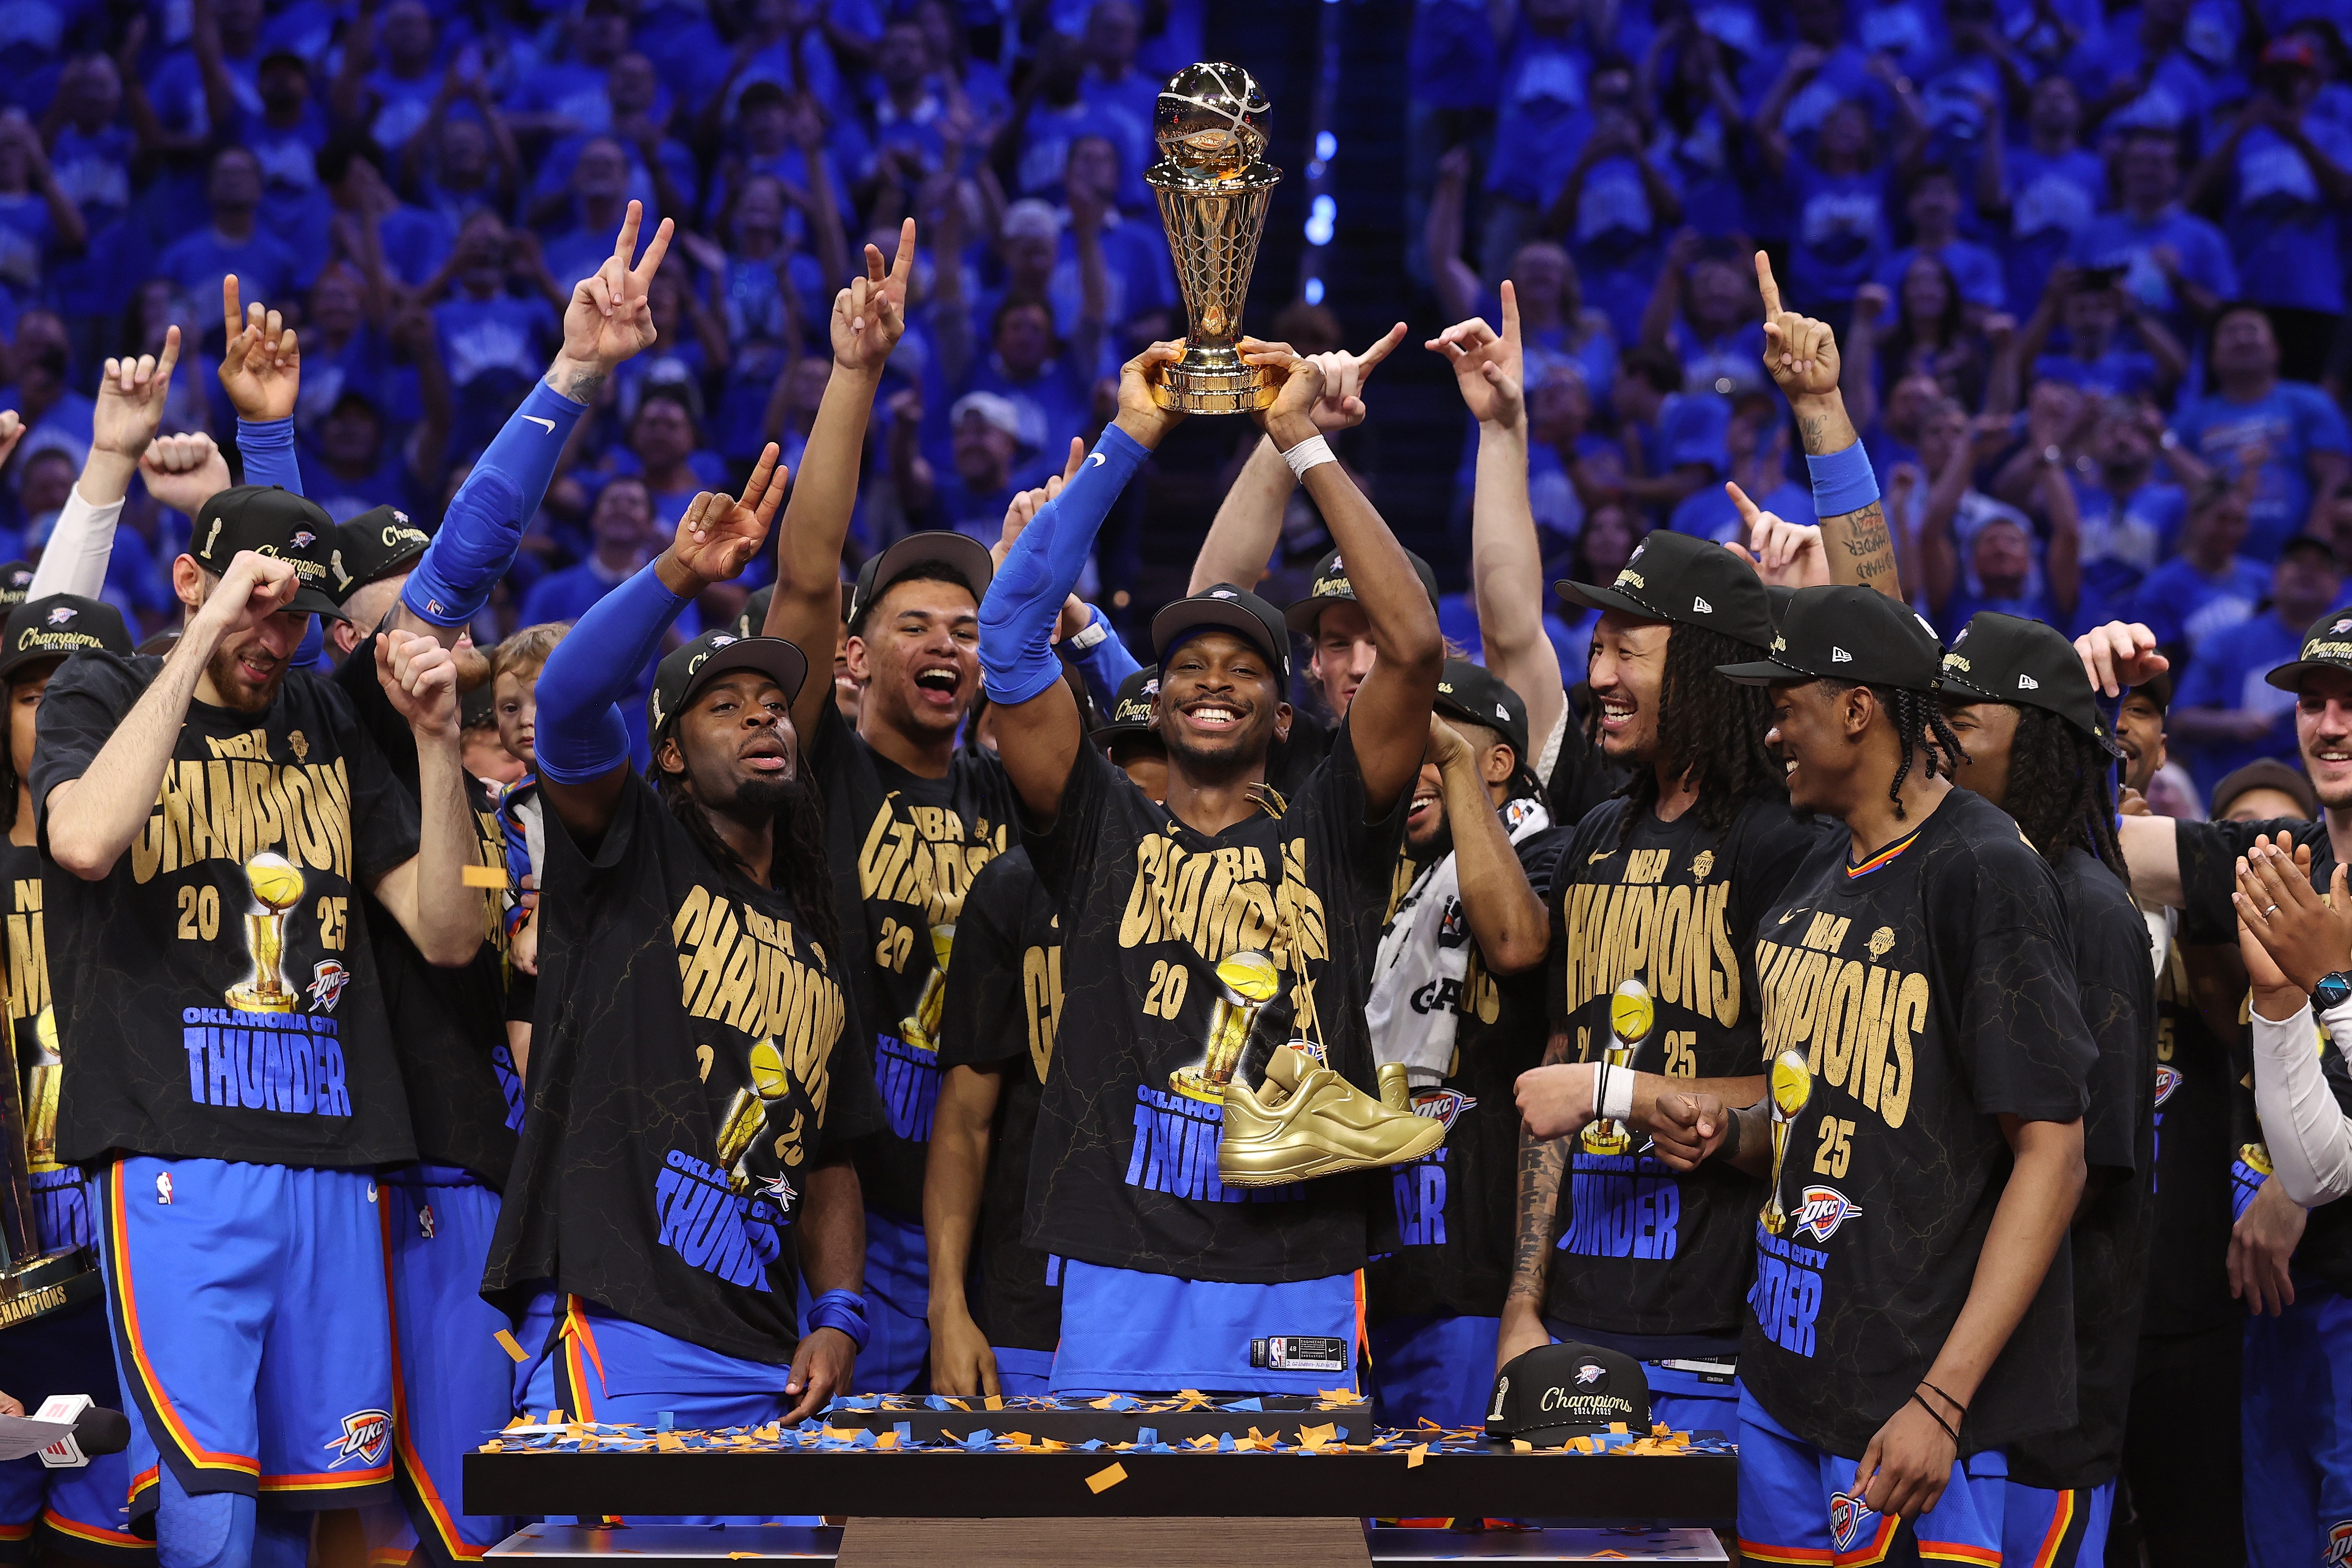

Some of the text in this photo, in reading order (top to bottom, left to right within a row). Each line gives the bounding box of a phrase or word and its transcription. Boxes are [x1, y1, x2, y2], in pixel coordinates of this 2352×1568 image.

[1182, 393, 1200, 409] NBA
[1202, 394, 1237, 410] FINALS
[1188, 376, 1205, 390] THE
[1208, 377, 1230, 391] BILL
[205, 729, 268, 762] NBA
[132, 756, 352, 884] CHAMPION
[1621, 849, 1671, 883] NBA
[178, 885, 220, 941] 20
[317, 896, 348, 951] 25
[743, 903, 795, 957] NBA
[875, 916, 914, 974] 20
[1801, 911, 1852, 954] NBA
[1564, 880, 1741, 1028] HAMPIONS
[1143, 960, 1188, 1020] 20
[183, 1006, 338, 1035] OKLAHOMA CITY
[2157, 1017, 2174, 1061] 5
[183, 1026, 352, 1117] THUNDER
[1664, 1030, 1697, 1079] 25
[1137, 1084, 1224, 1122] OKLAHO
[1414, 1097, 1452, 1118] OKC
[1813, 1115, 1856, 1179] 25
[1800, 1200, 1839, 1225] OKC
[1791, 1246, 1830, 1269] CITY
[1540, 1386, 1633, 1415] Champions
[1573, 1407, 1612, 1416] 2024 2025
[345, 1421, 384, 1453] OKC
[1832, 1504, 1848, 1536] OKC
